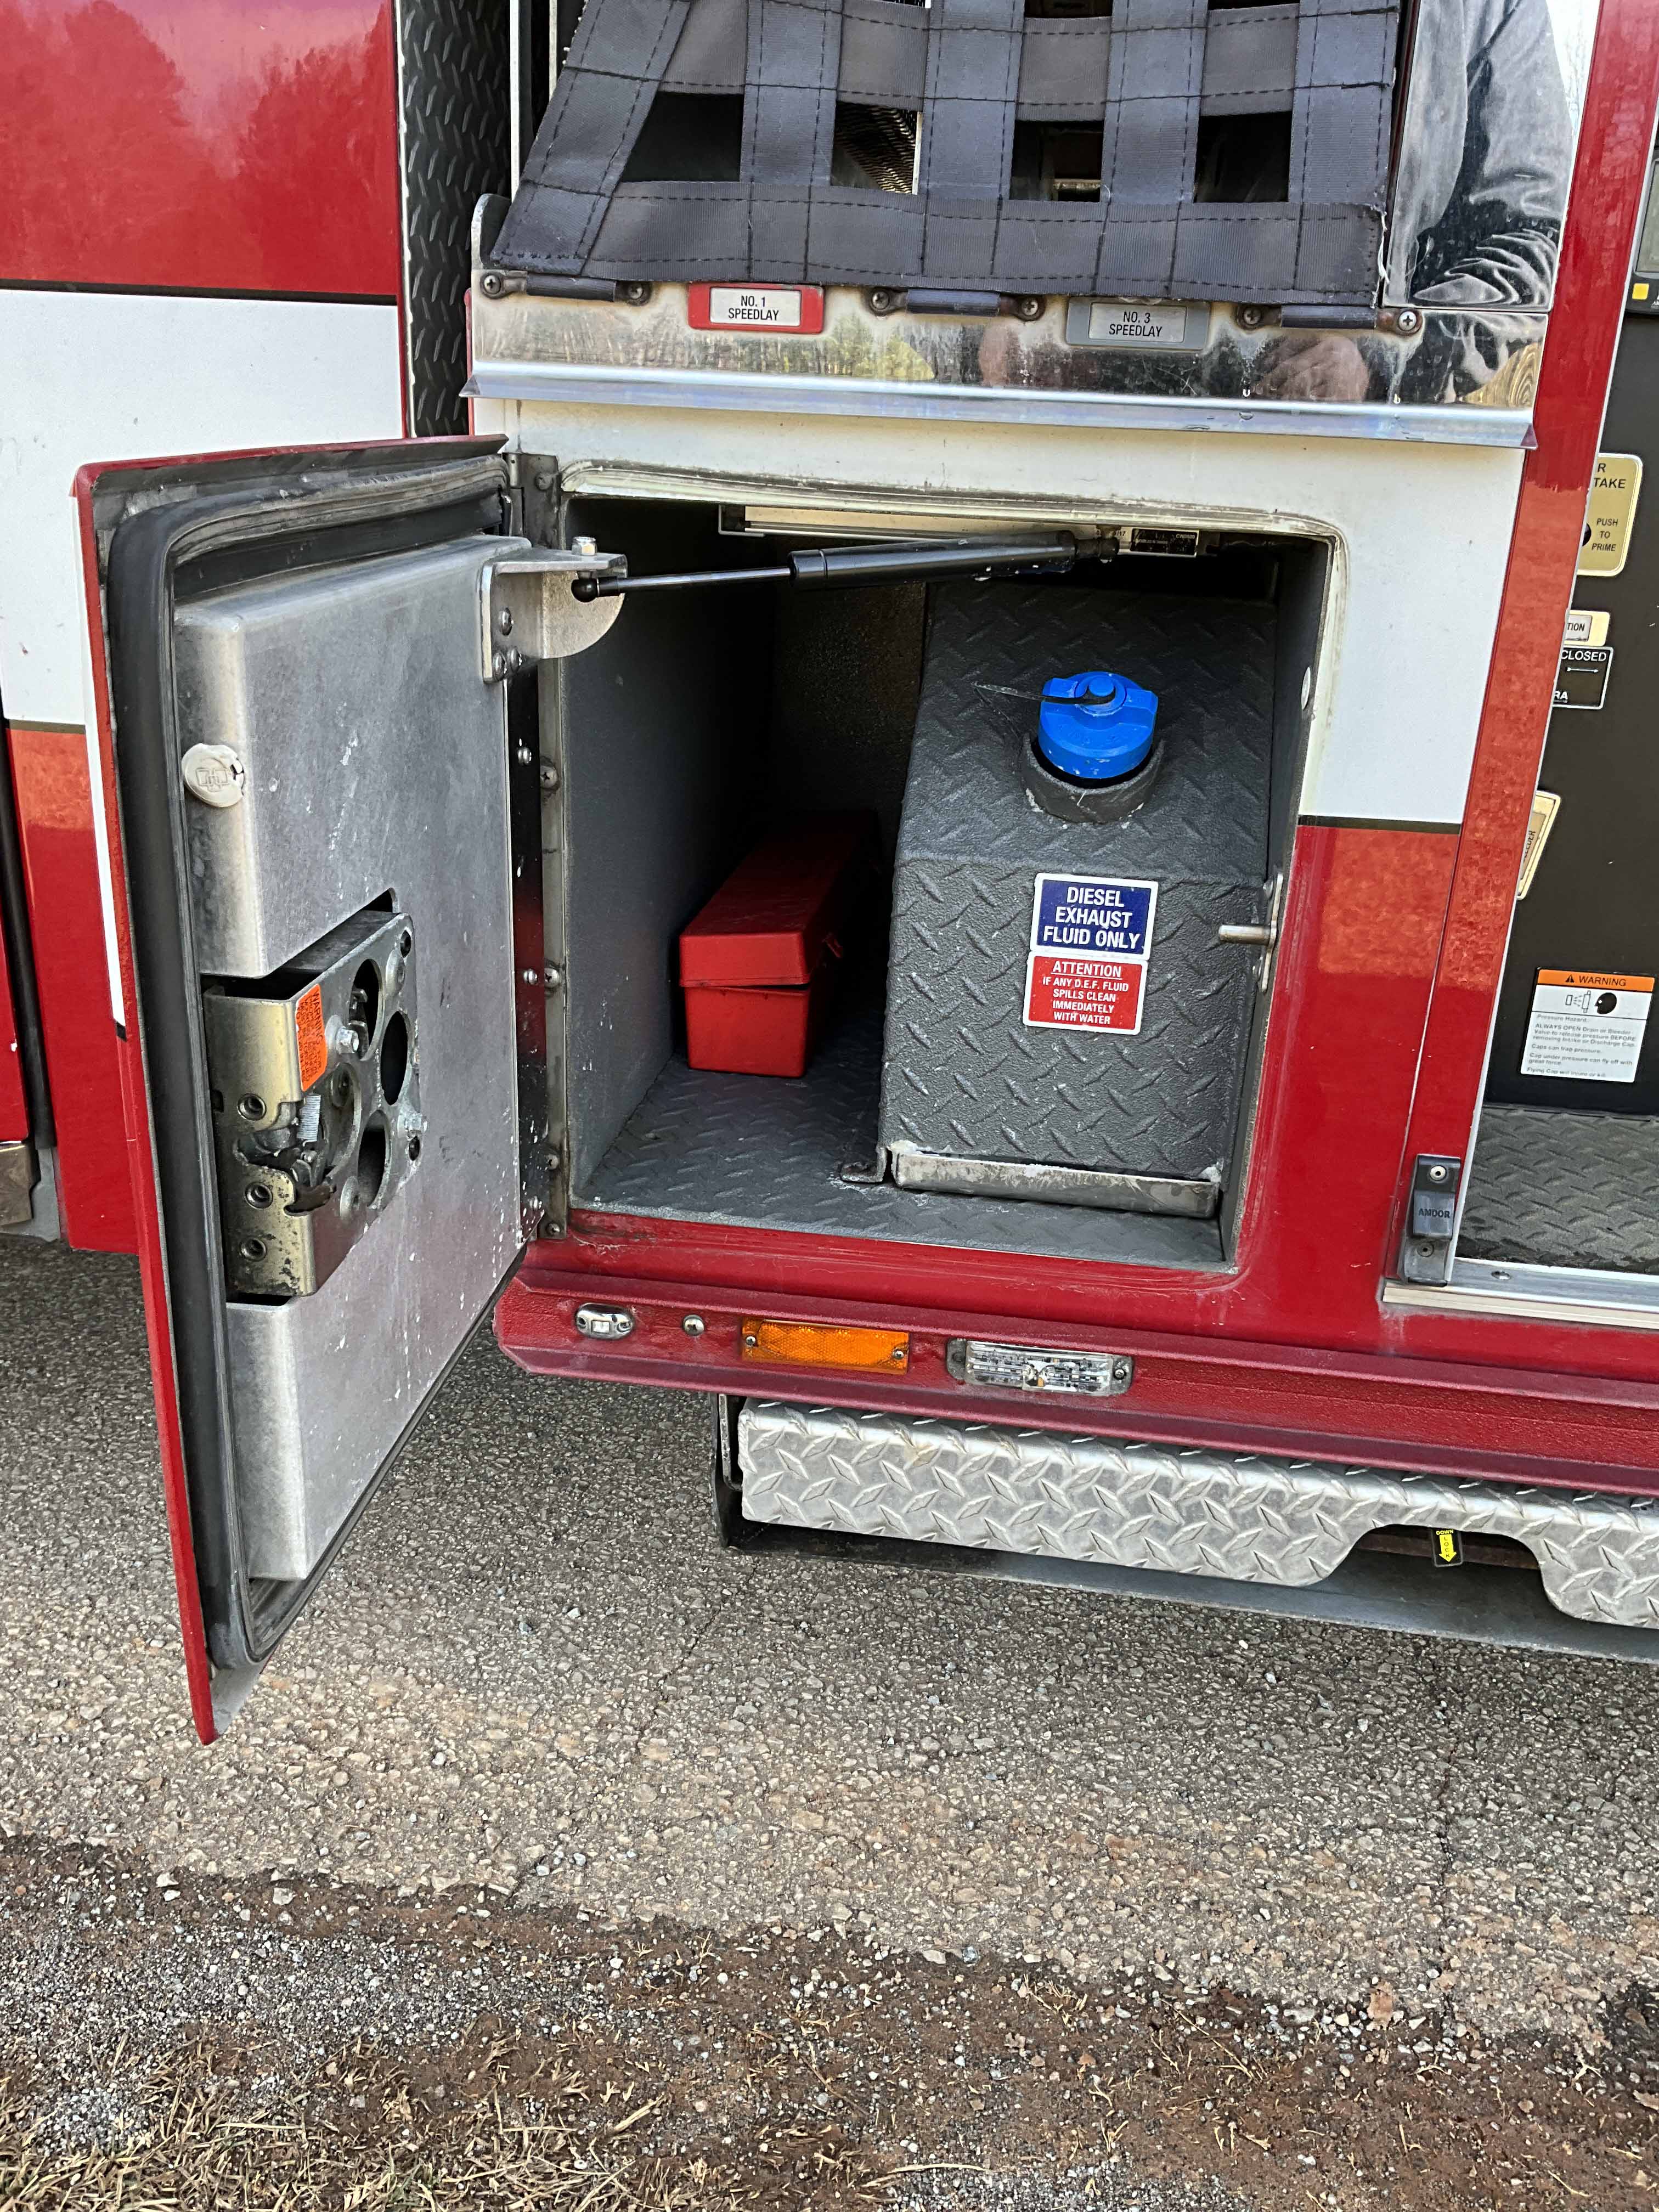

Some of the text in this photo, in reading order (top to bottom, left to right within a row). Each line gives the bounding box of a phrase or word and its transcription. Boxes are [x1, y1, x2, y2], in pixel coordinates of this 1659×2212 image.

[741, 295, 766, 308] NO. 1
[728, 308, 779, 321] SPEEDLAY
[1123, 311, 1150, 324] NO. 3
[1109, 324, 1163, 337] SPEEDLAY
[1597, 462, 1606, 473] R
[1594, 477, 1627, 489] TAKE
[1596, 518, 1618, 527] PUSH
[1599, 531, 1611, 539] TO
[1592, 543, 1616, 552] PRIME
[1567, 623, 1585, 631] TION
[1561, 650, 1607, 662] CLOSED
[1554, 690, 1568, 700] RA
[1066, 887, 1125, 907] DIESEL
[1055, 906, 1133, 929] EXHAUST
[1043, 926, 1141, 949] FLUID ONLY
[1052, 961, 1122, 978] ATTENTION
[1042, 976, 1128, 992] IF ANY D.E.F. FLUID
[1579, 975, 1627, 986] WARNING
[1053, 989, 1116, 1002] SPILLS CLEAN
[1053, 1000, 1114, 1013] IMMEDIATELY
[1053, 1012, 1111, 1025] WITH WATER
[1418, 1208, 1450, 1218] ANDOR
